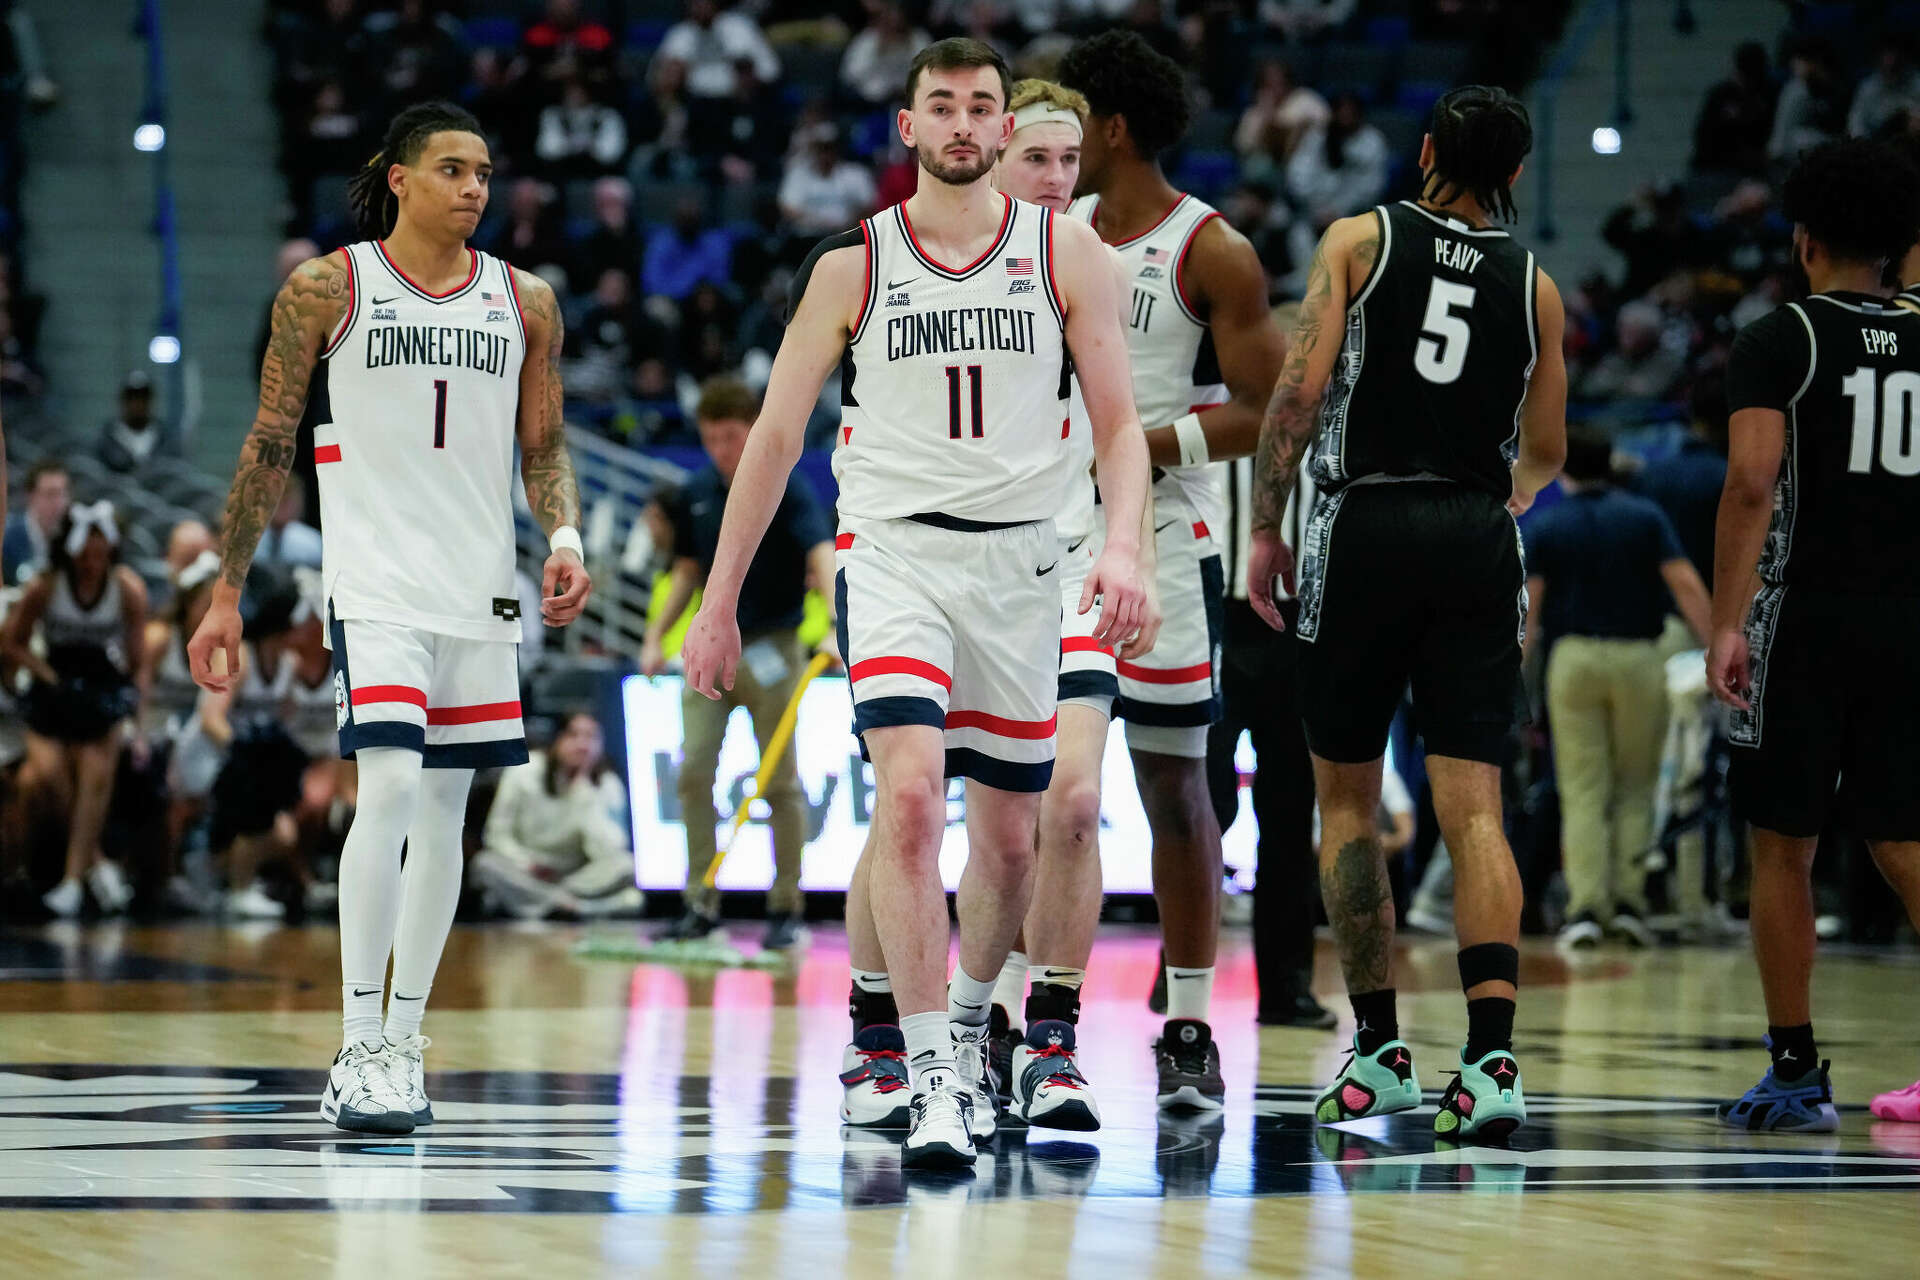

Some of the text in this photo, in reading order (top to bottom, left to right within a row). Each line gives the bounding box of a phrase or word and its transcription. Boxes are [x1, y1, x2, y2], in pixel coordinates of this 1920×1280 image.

[1434, 237, 1484, 274] PEAVY
[897, 292, 910, 300] THE
[366, 326, 510, 378] CONNECTICUT
[887, 307, 1035, 362] CONNECTICUT
[1414, 275, 1477, 385] 5
[1861, 327, 1898, 356] EPPS
[433, 379, 448, 449] 1
[945, 365, 984, 439] 11
[1842, 366, 1920, 476] 10
